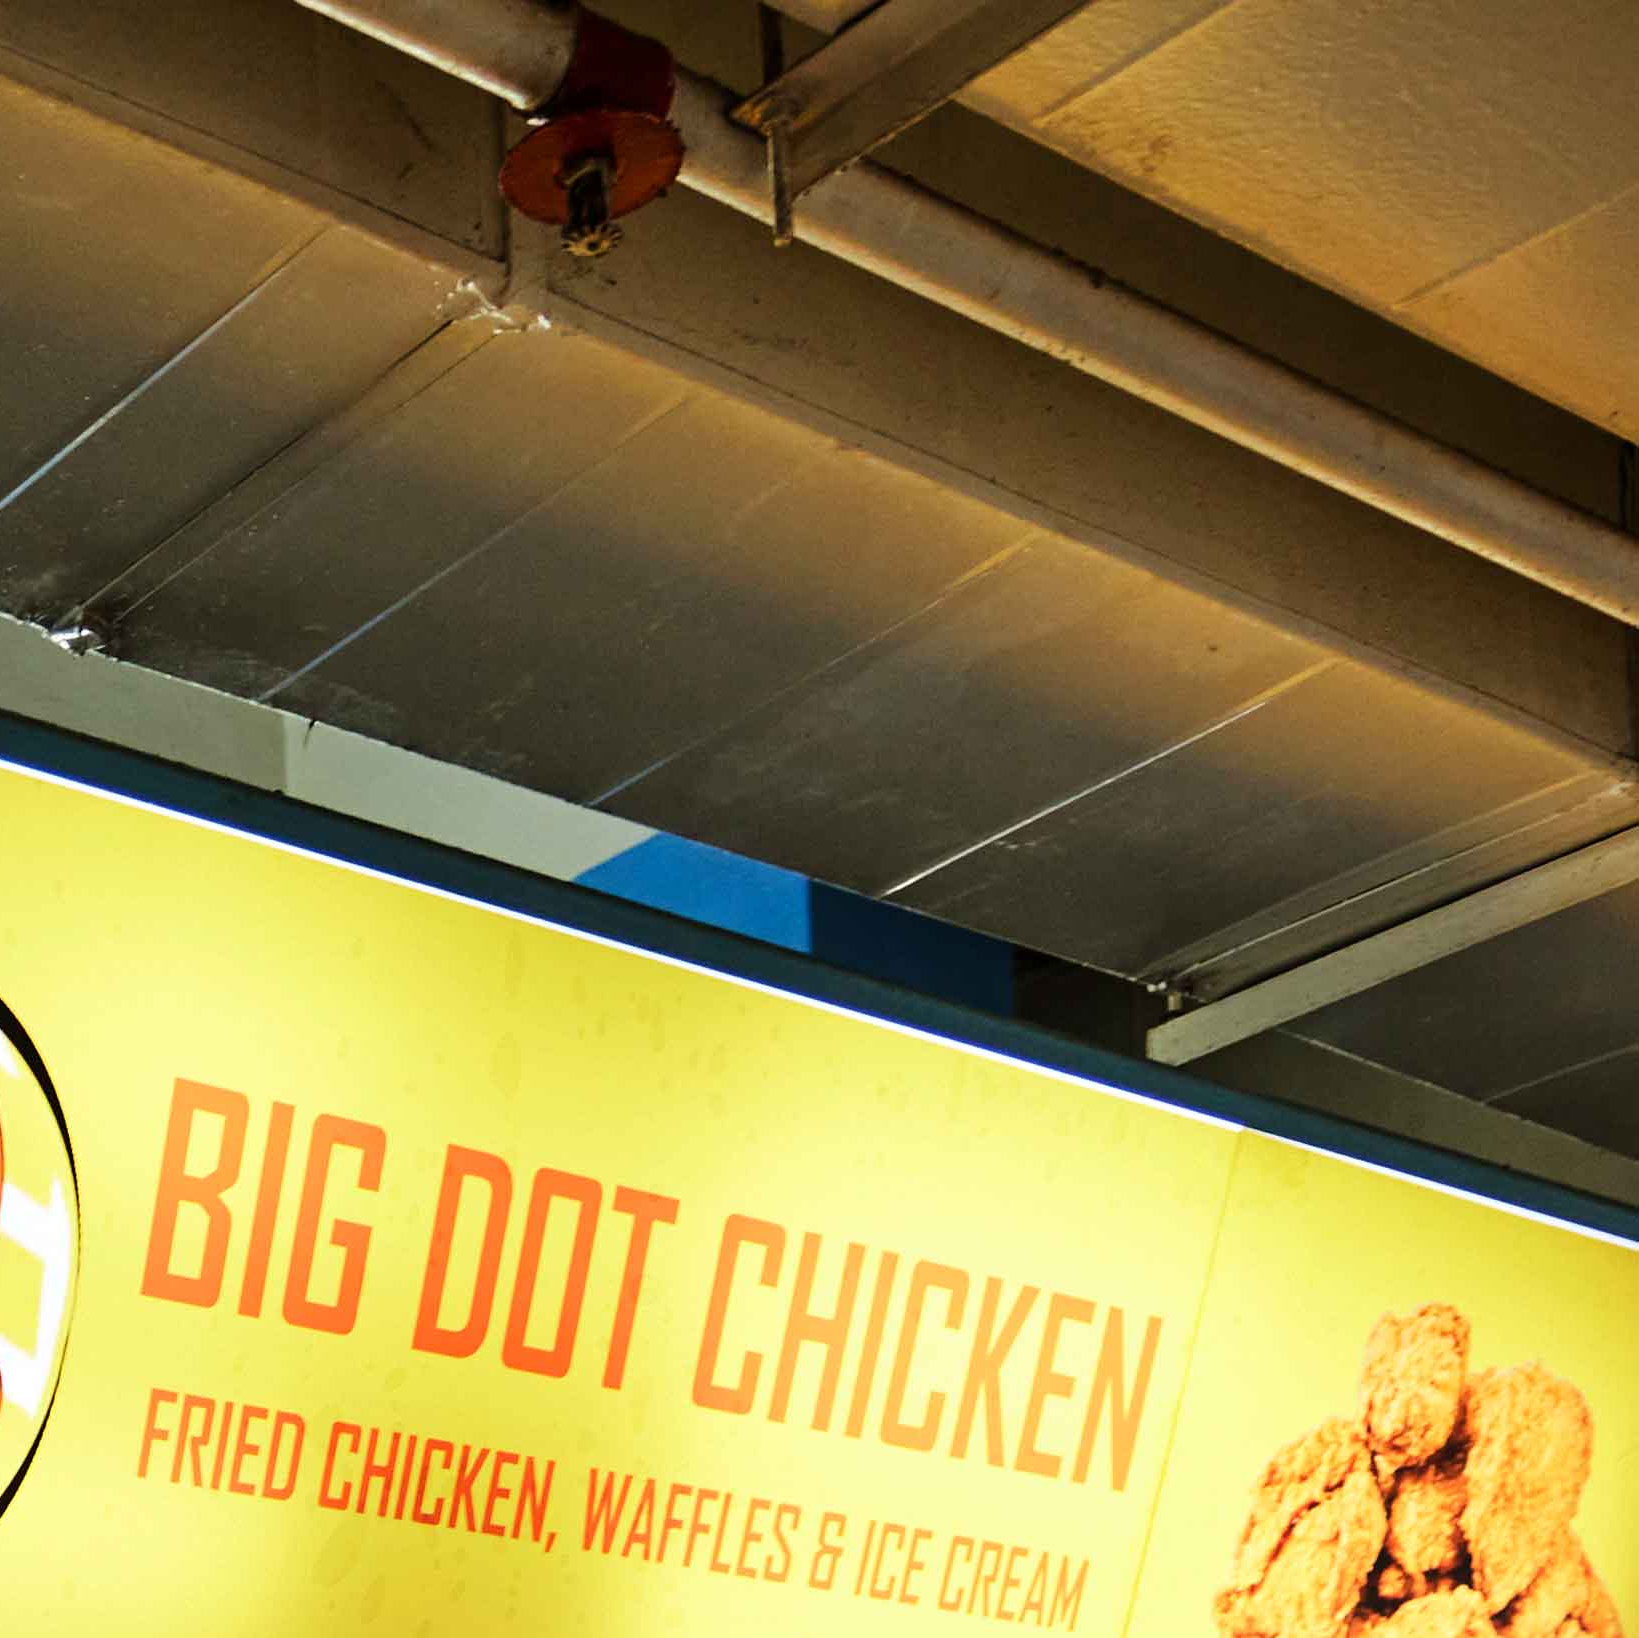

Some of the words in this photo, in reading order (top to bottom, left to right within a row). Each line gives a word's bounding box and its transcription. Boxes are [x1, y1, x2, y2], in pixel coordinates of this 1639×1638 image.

[141, 1077, 387, 1336] BIG
[412, 1143, 680, 1391] DOT
[691, 1213, 1161, 1492] CHICKEN
[136, 1387, 306, 1501] FRIED
[317, 1421, 556, 1551] CHICKEN,
[582, 1467, 796, 1585] WAFFLES
[807, 1511, 847, 1590] &
[853, 1520, 932, 1605] ICE
[937, 1535, 1089, 1632] CREAM
